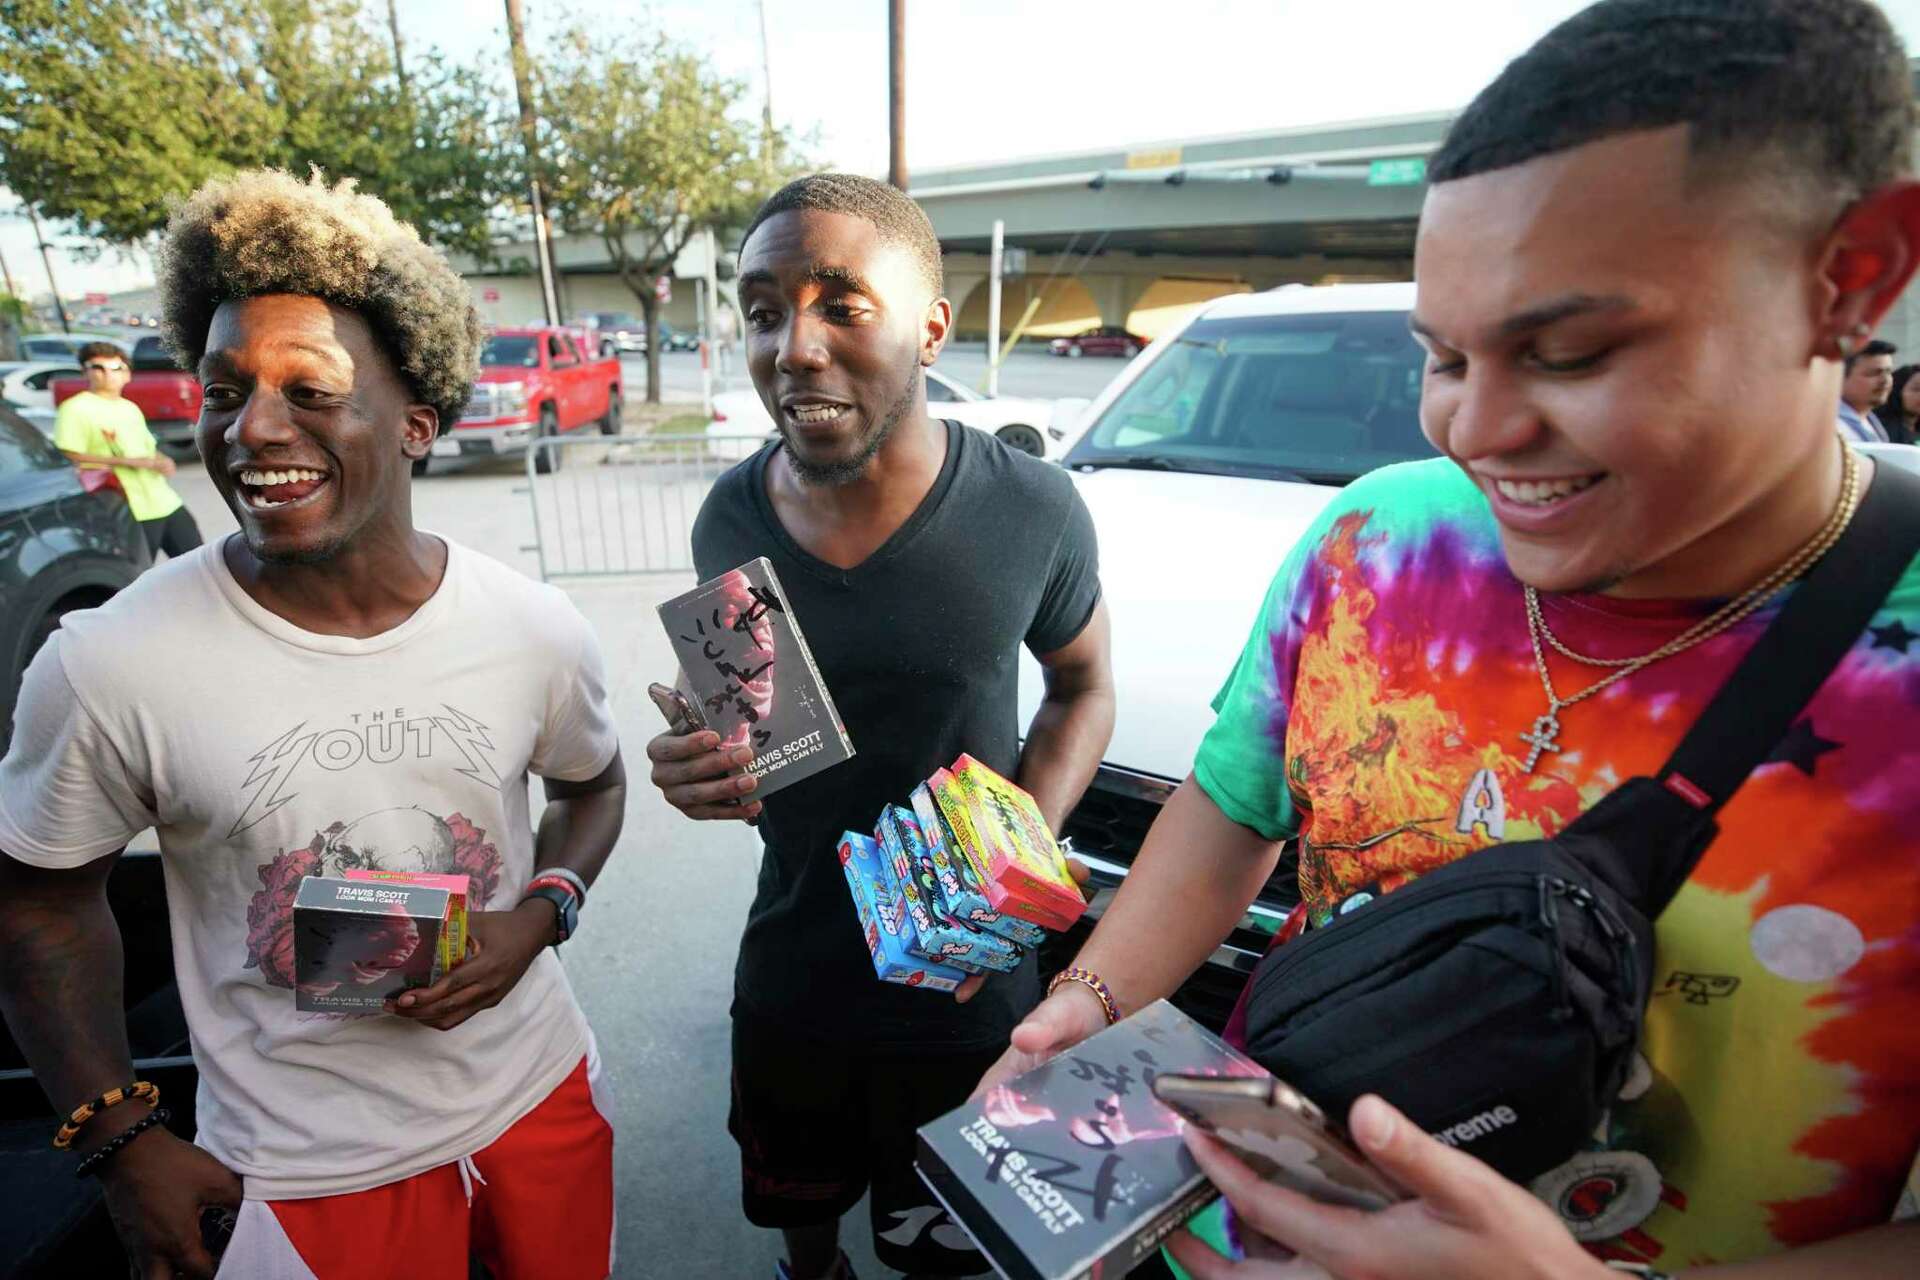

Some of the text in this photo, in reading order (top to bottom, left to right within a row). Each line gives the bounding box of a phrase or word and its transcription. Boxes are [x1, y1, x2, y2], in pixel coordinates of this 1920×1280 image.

[351, 707, 405, 724] THE
[782, 730, 821, 755] SCOTT
[768, 759, 790, 772] MOM
[792, 750, 810, 761] CAN
[809, 742, 825, 754] FLY
[226, 703, 502, 842] YOUTH
[950, 808, 971, 846] PATCH
[336, 886, 410, 900] TRAVIS SCOTT
[941, 943, 974, 954] Trolli
[1039, 1209, 1065, 1235] FLY
